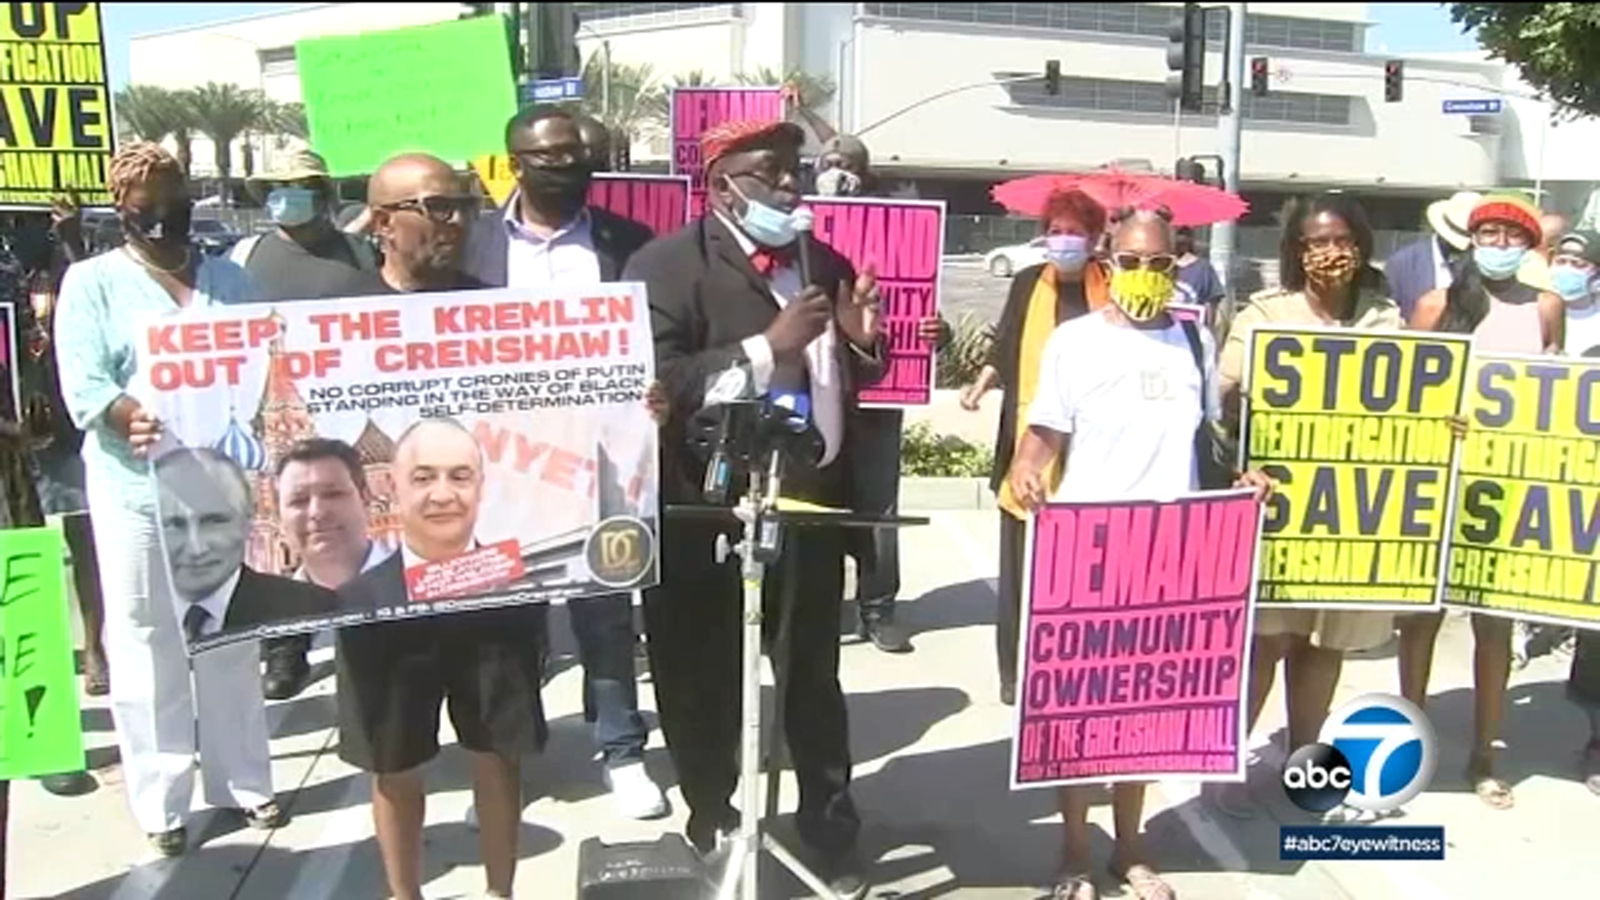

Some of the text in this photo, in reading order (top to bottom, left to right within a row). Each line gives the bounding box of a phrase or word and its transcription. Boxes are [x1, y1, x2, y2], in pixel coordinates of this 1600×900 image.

[148, 297, 635, 355] KEEP THE KREMLIN
[151, 356, 247, 391] OUT
[284, 350, 341, 379] OF
[307, 377, 645, 415] STANDING IN THE WAY OF BLACK
[310, 364, 645, 400] NO CORRUPT CRONIES OF PUTIN
[1262, 337, 1454, 412] STOP
[419, 391, 643, 418] SELF-DETERMINATION
[1250, 413, 1451, 463] GENTRIFICATION
[1261, 465, 1438, 537] SAVE
[1460, 480, 1600, 554] SAV
[1033, 500, 1259, 610] DEMAND
[1448, 547, 1591, 602] CRENSHAW
[1032, 608, 1242, 663] COMMUNITY
[1030, 655, 1237, 709] OWNERSHIP
[1022, 707, 1236, 763] OF THE CRENSHAW MALL
